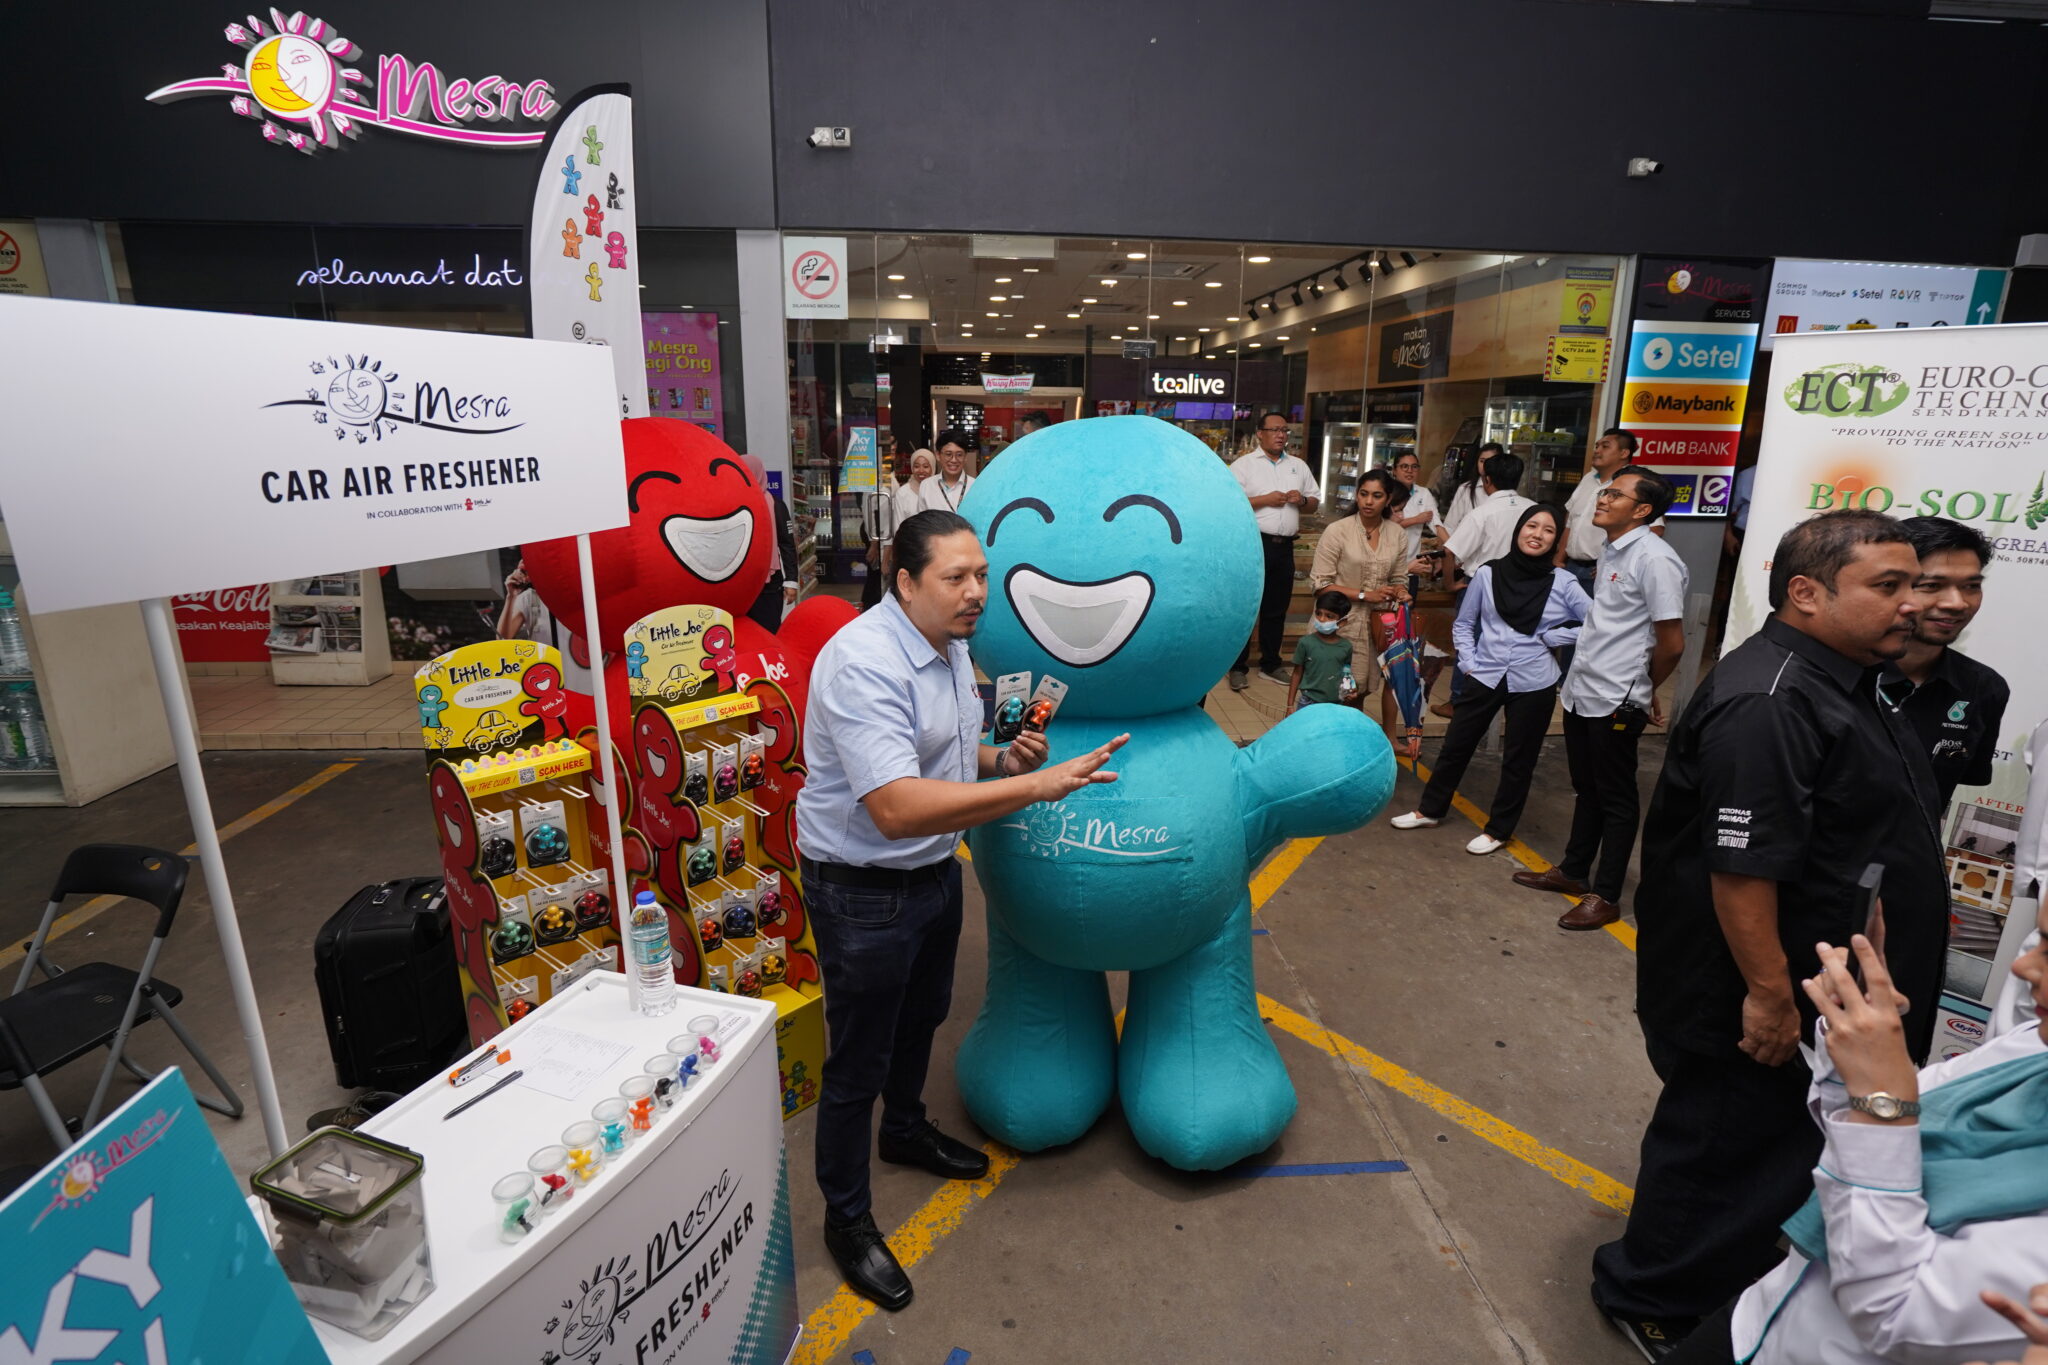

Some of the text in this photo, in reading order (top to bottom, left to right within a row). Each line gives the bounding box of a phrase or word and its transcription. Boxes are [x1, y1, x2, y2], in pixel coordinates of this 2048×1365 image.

[376, 53, 557, 124] Mesra
[297, 258, 455, 286] selamat
[1703, 276, 1753, 296] Mesra
[1775, 288, 1807, 296] GROUND
[1776, 282, 1808, 290] COMMON
[1859, 288, 1884, 300] Setel
[1715, 309, 1751, 319] SERVICES
[1403, 327, 1428, 342] makan
[648, 340, 698, 355] Mesra
[1677, 342, 1743, 369] Setel
[675, 355, 712, 373] Ong
[1151, 372, 1225, 395] tealive
[414, 381, 512, 425] Mesra
[1655, 394, 1736, 414] Maybank
[1887, 438, 1908, 446] TO
[1914, 438, 1946, 447] THE
[1934, 430, 1992, 439] GREEN
[1645, 441, 1732, 456] CIMB BANK
[261, 456, 541, 504] CAR AIR FRESHENER
[366, 512, 376, 520] IN
[377, 505, 443, 519] COLLABORATION
[444, 503, 463, 512] WITH
[649, 620, 702, 642] Little Joe
[448, 658, 521, 686] Little Joe
[484, 689, 513, 700] FRESHENER
[719, 701, 755, 716] SCAN HERE
[1941, 739, 1962, 747] BOSS
[538, 758, 585, 778] SCAN HERE
[477, 780, 493, 791] THE
[493, 778, 511, 788] CLUB
[643, 796, 659, 819] Little
[1718, 807, 1752, 816] PETRONAS
[1974, 796, 2025, 814] AFTER
[1083, 817, 1171, 848] Mesra
[1717, 828, 1750, 838] PETRONAS
[445, 868, 462, 894] Little
[1955, 1022, 1983, 1036] MyIPO
[106, 1109, 168, 1167] Mesra
[645, 1168, 731, 1291] Mesra
[636, 1202, 754, 1365] FRESHENER
[677, 1321, 699, 1351] WITH
